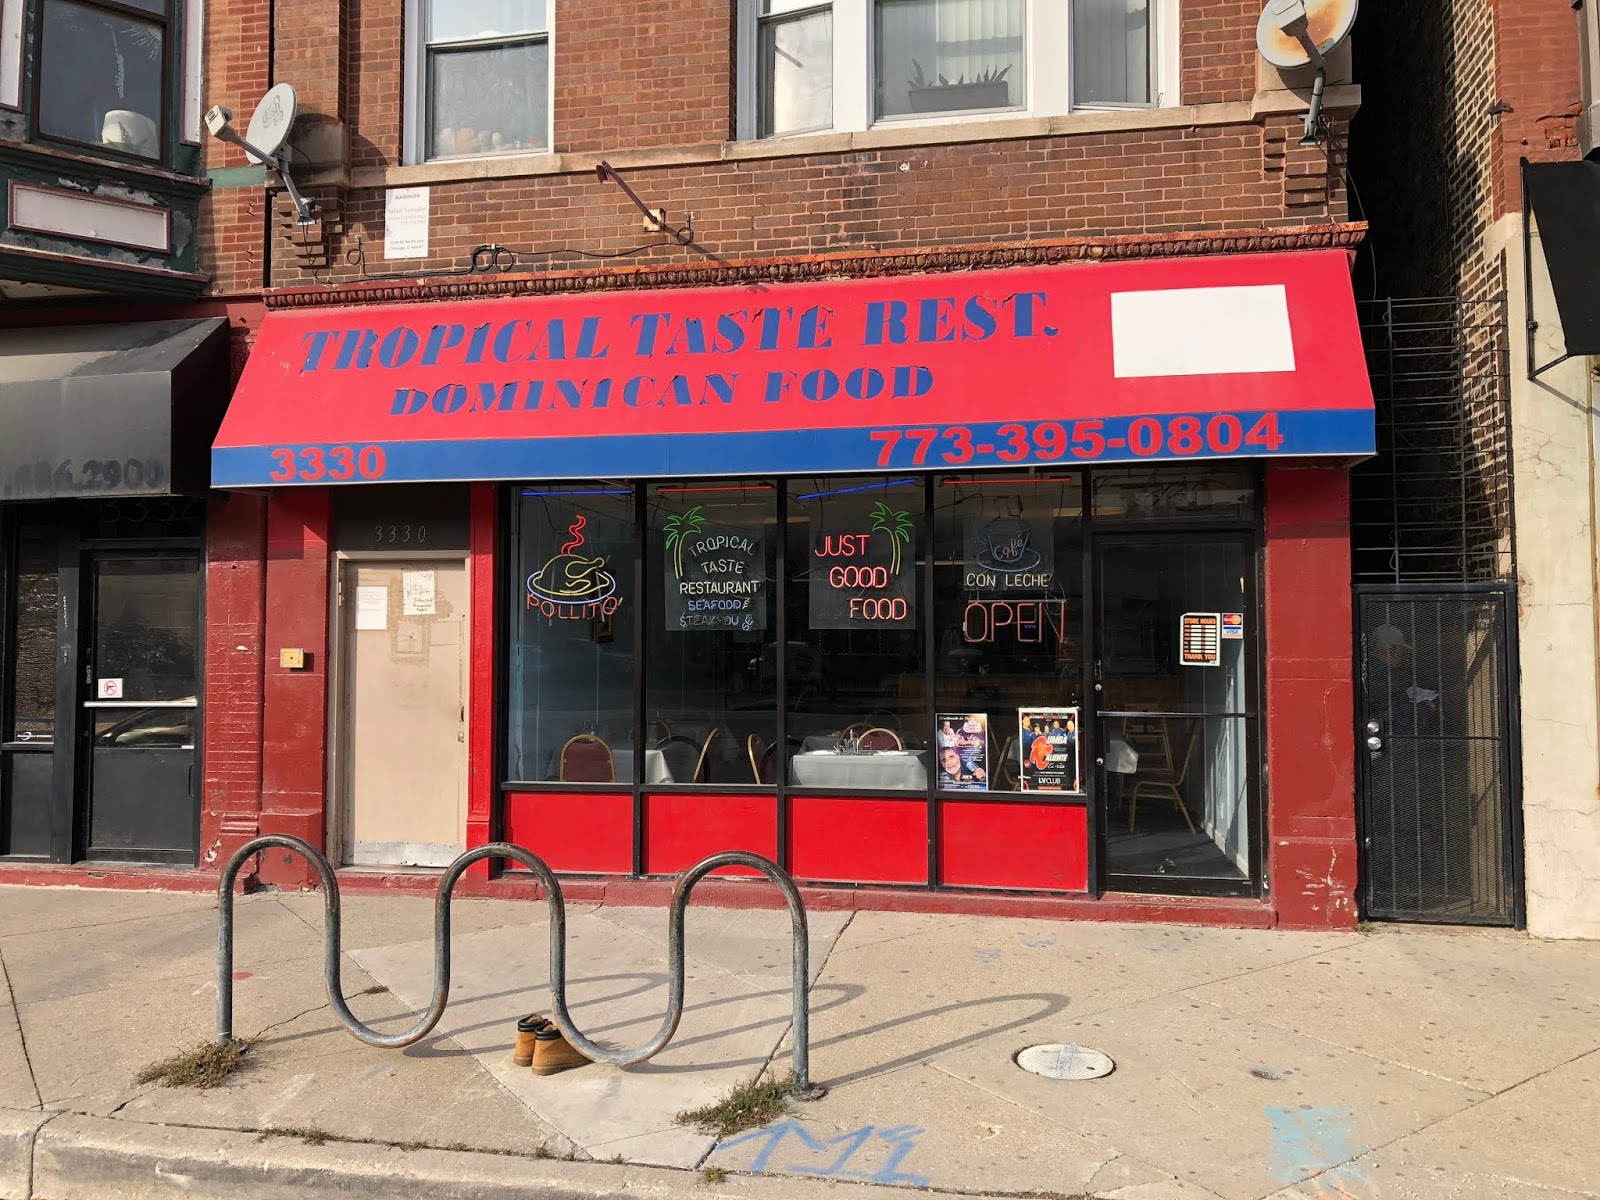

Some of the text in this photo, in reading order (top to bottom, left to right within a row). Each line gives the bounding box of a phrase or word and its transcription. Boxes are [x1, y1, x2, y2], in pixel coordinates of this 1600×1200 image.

[301, 291, 1059, 373] TROPICAL TASTE REST.
[388, 365, 934, 417] DOMINICAN FOOD
[869, 411, 1284, 468] 773-395-0804
[269, 445, 386, 482] 3330
[374, 525, 426, 543] 3330
[814, 534, 871, 557] JUST
[688, 535, 755, 558] TROPICAL
[994, 533, 1024, 560] Café
[701, 558, 745, 575] TASTE
[829, 565, 888, 588] GOOD
[679, 580, 760, 595] RESTAURANT
[966, 573, 1049, 587] CON LECHE
[526, 592, 619, 620] POLLITO
[687, 599, 741, 611] SEAFOOD
[849, 598, 907, 620] FOOD
[964, 602, 1065, 644] OPEN
